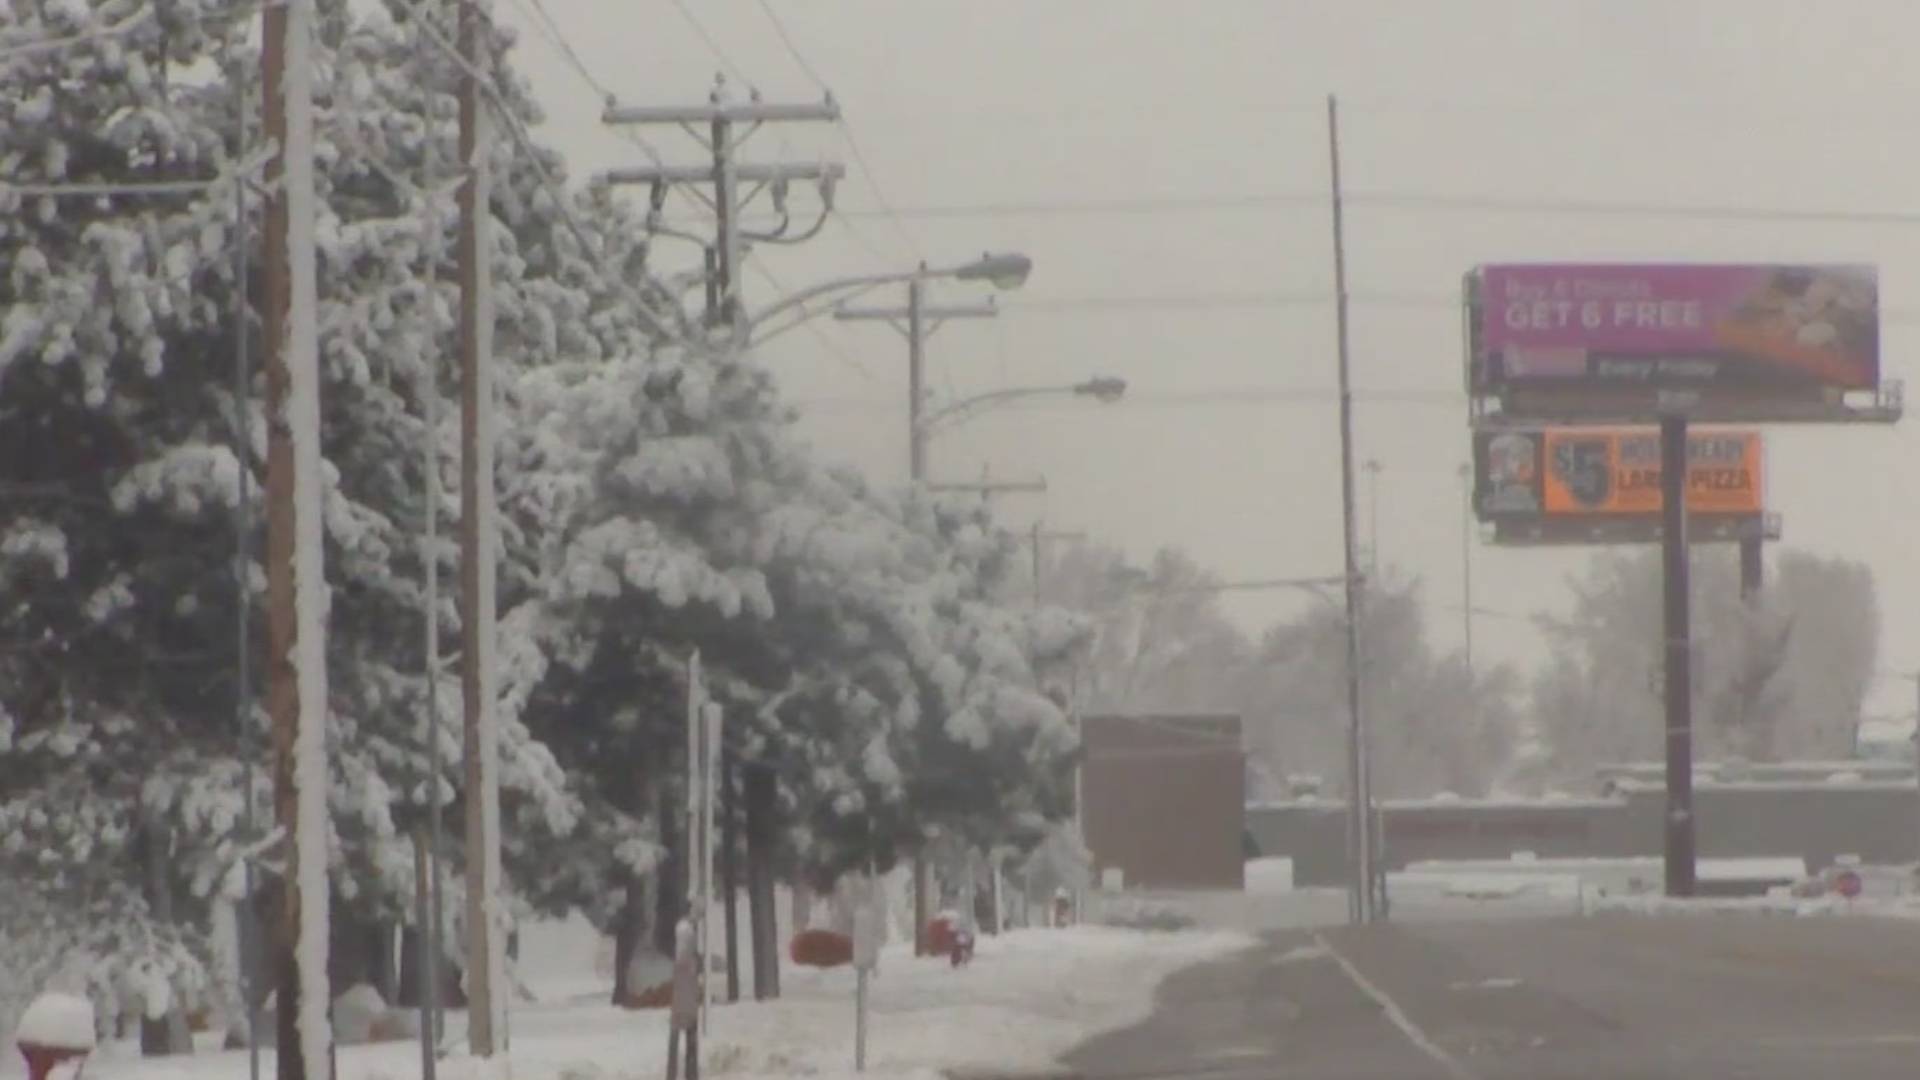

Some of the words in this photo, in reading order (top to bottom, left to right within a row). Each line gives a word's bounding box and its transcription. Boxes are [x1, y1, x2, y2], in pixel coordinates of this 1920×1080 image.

[1504, 300, 1572, 330] GET
[1581, 300, 1602, 330] 6
[1613, 299, 1702, 328] FREE
[1690, 467, 1751, 490] PIZZA
